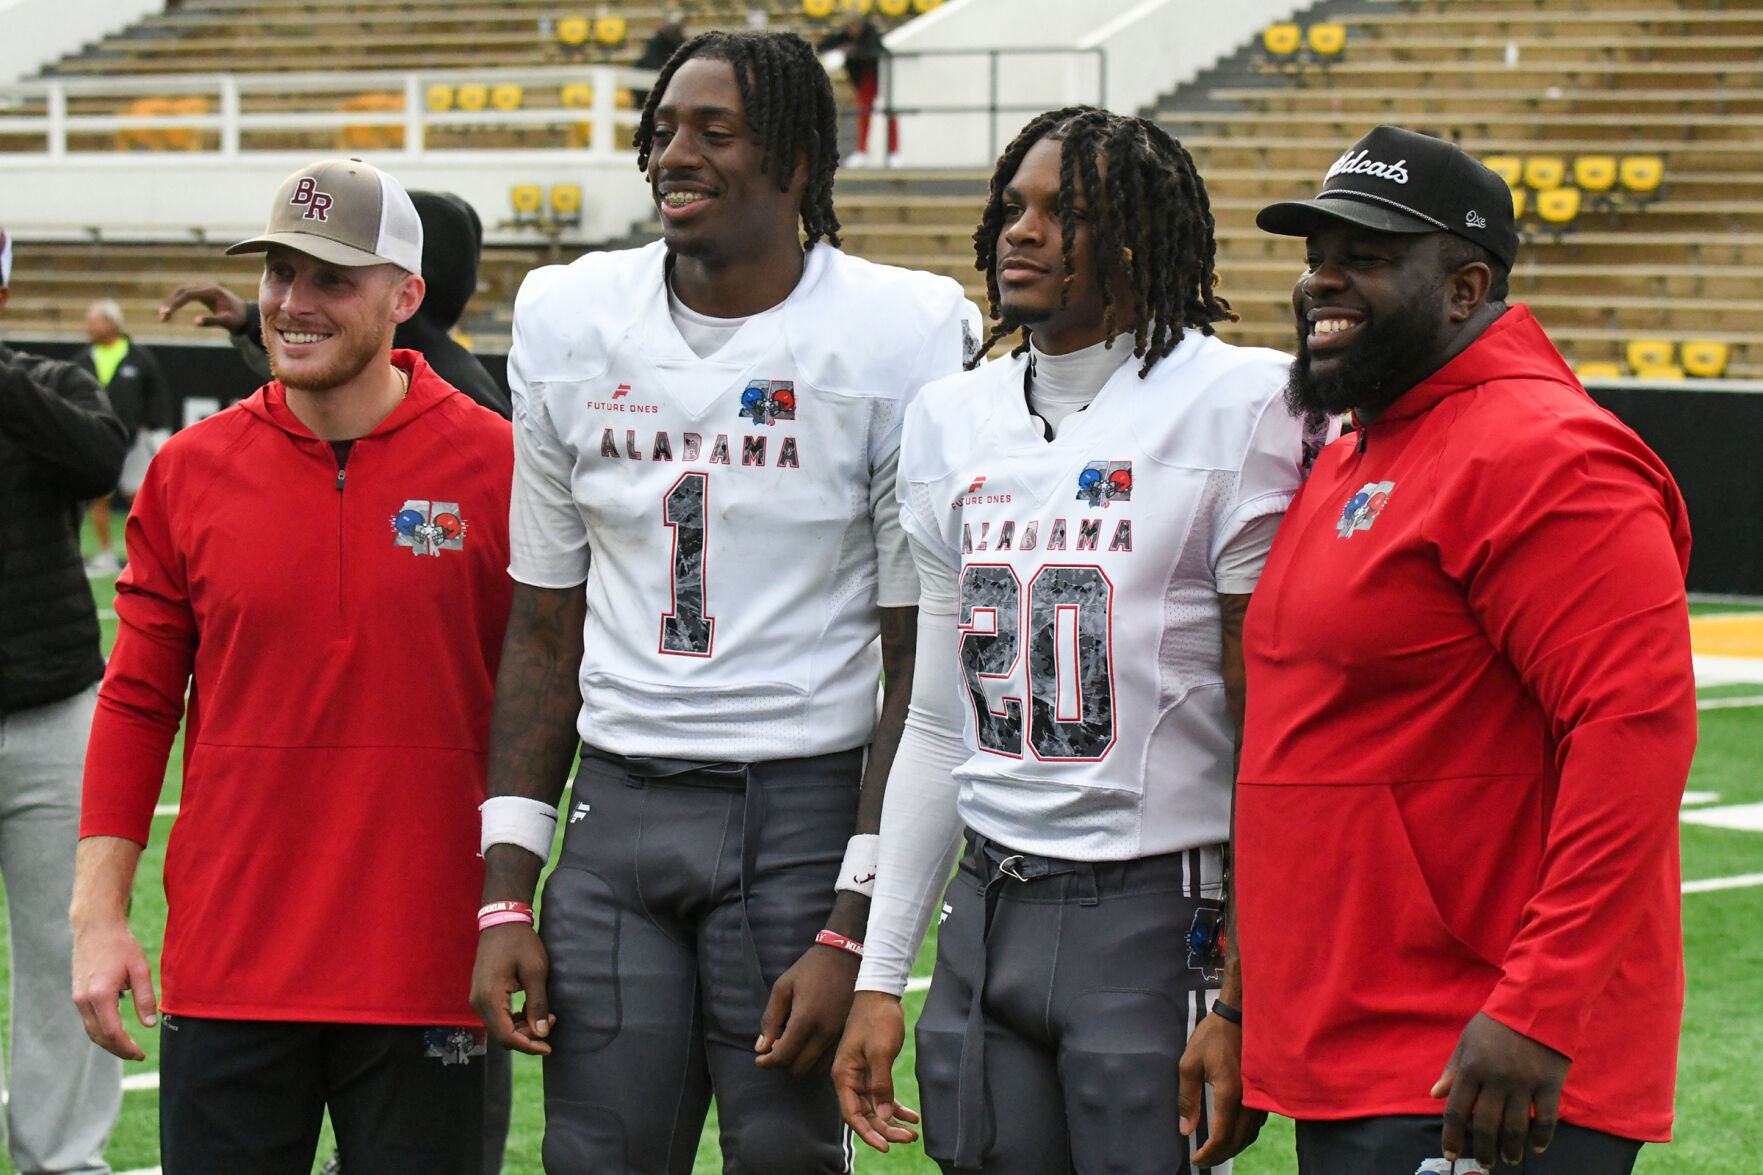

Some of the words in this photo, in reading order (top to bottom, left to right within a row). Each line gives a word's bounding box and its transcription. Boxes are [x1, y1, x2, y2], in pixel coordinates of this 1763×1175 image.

[587, 401, 625, 413] FUTURE
[629, 403, 658, 414] ONES
[600, 427, 800, 469] ALABAMA
[986, 494, 1012, 504] ONES
[961, 518, 1133, 554] ALABAMA
[658, 471, 716, 658] 1
[957, 563, 1118, 763] 20
